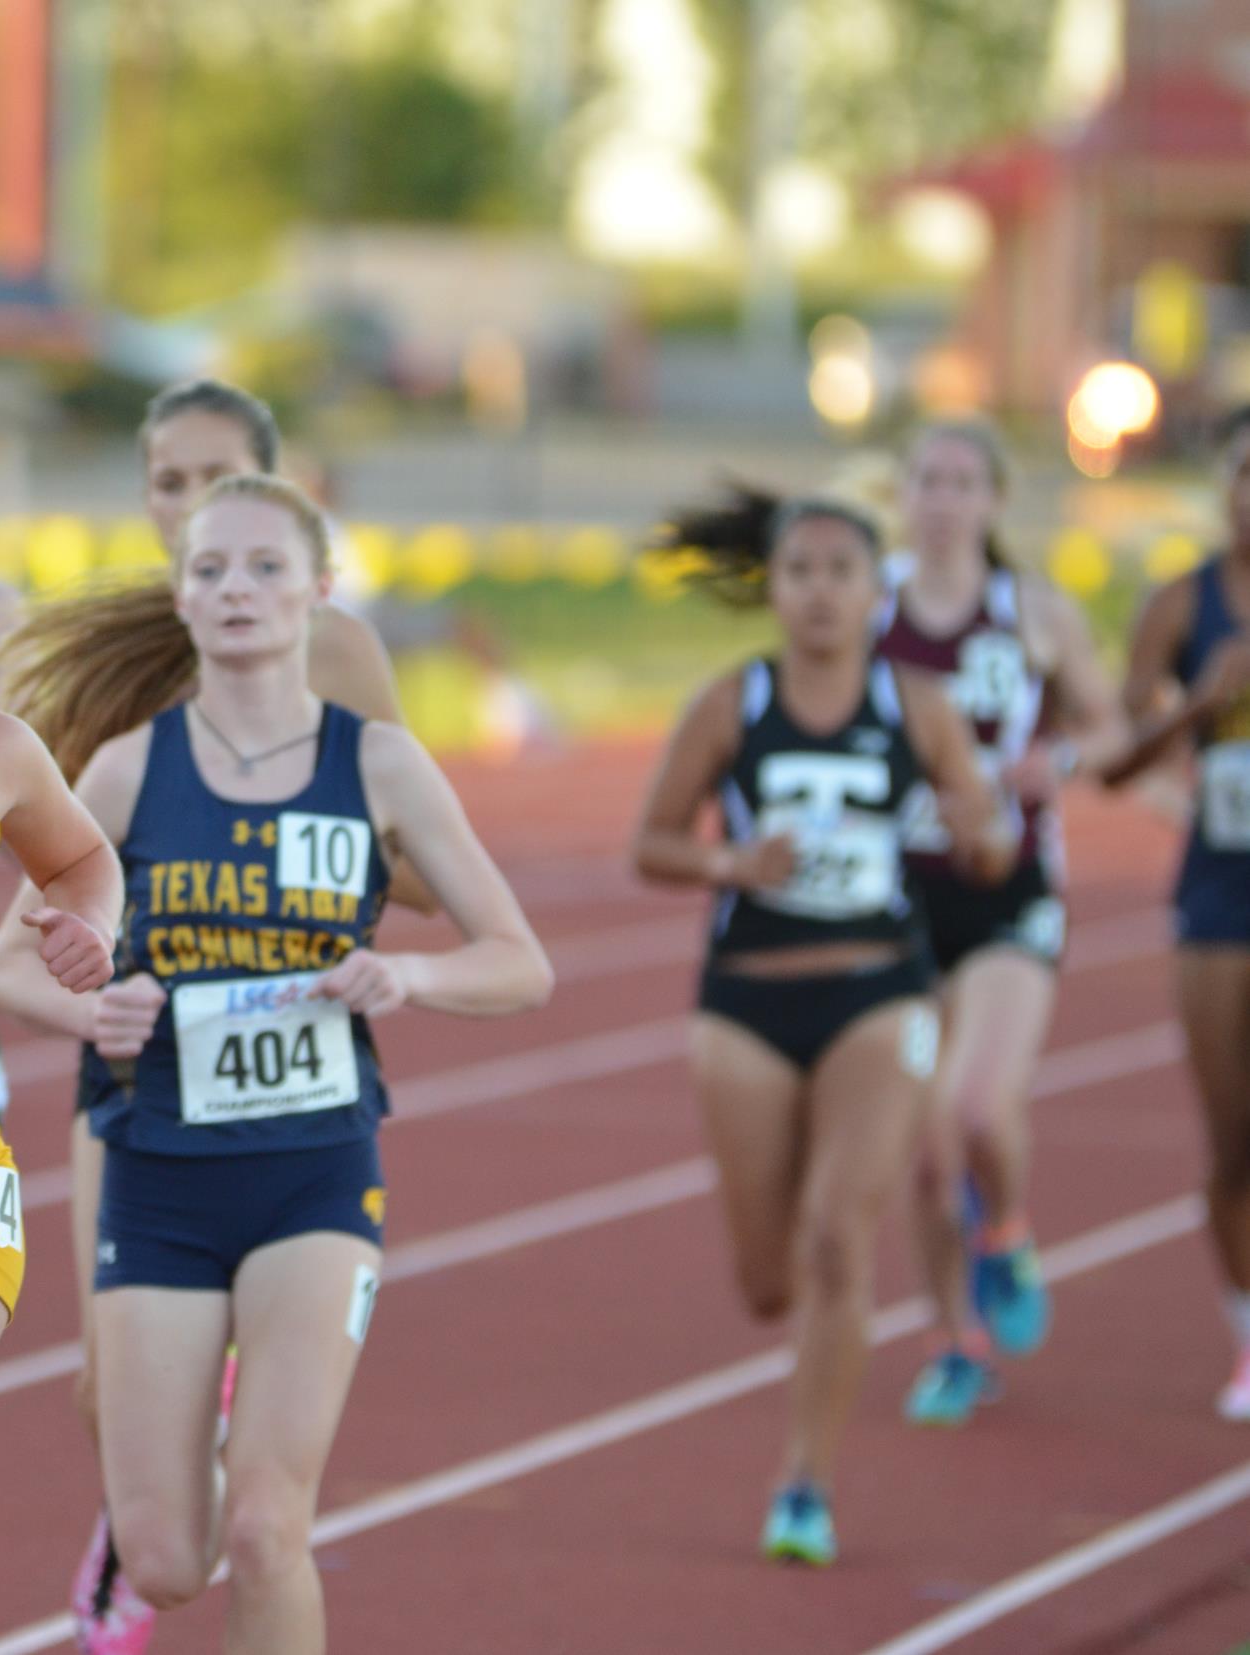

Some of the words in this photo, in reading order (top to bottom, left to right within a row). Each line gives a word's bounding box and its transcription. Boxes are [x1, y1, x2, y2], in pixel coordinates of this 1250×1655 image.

[298, 823, 356, 884] 10
[149, 861, 269, 917] TEXAS
[214, 1022, 325, 1092] 404
[0, 1172, 17, 1242] 4
